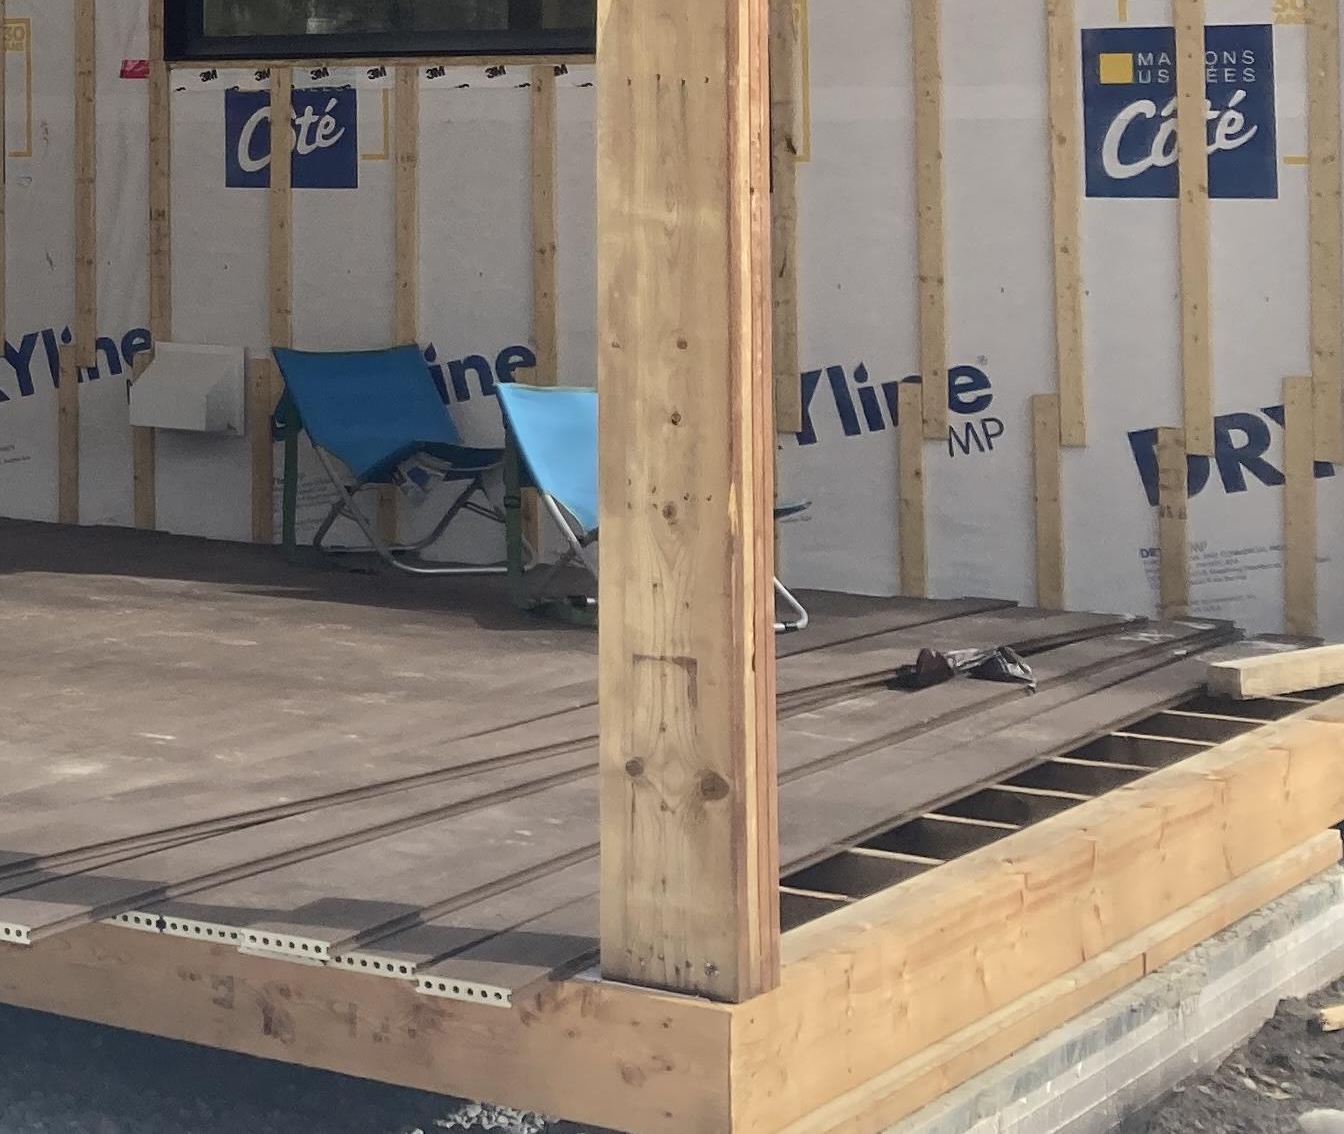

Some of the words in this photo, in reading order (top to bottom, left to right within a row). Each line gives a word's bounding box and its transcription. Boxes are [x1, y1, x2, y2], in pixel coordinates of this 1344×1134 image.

[1137, 49, 1256, 66] MAONS
[199, 68, 218, 83] 3M
[310, 66, 330, 81] 3M
[366, 65, 387, 80] 3M
[425, 65, 446, 80] 3M
[485, 65, 507, 79] 3M
[1137, 67, 1257, 84] USÉES
[948, 417, 1005, 458] MP
